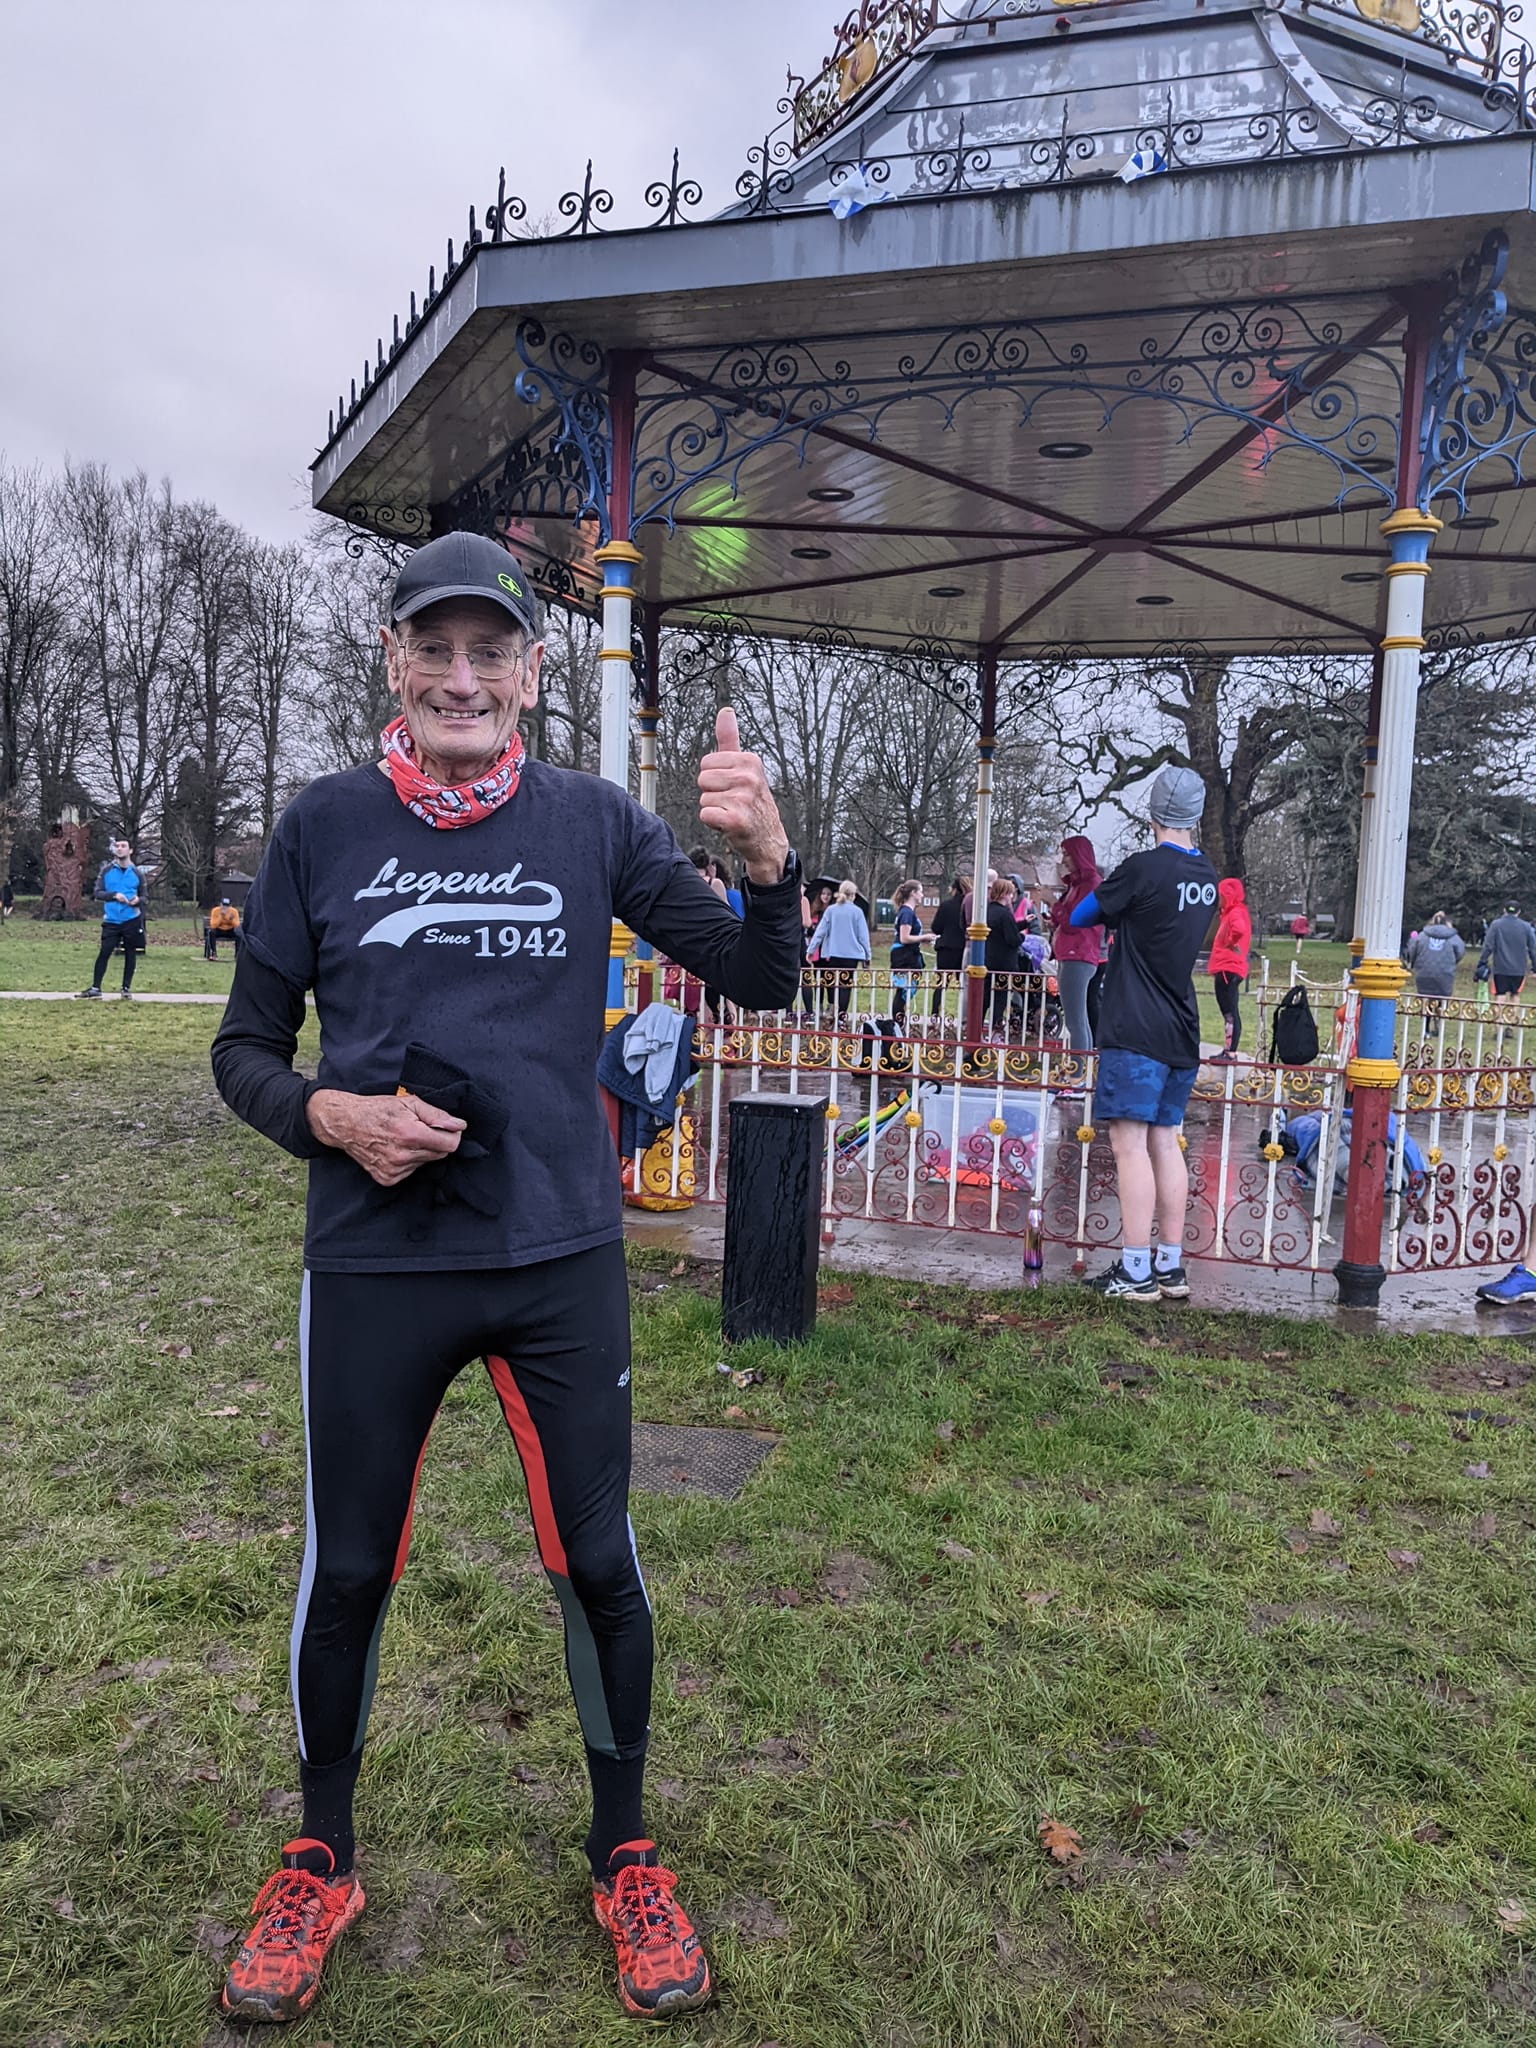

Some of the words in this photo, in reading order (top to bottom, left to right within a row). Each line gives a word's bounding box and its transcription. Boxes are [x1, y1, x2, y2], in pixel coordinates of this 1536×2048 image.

[354, 857, 523, 904] Legend
[1177, 882, 1217, 912] 100
[423, 928, 471, 944] Since
[474, 926, 567, 957] 1942
